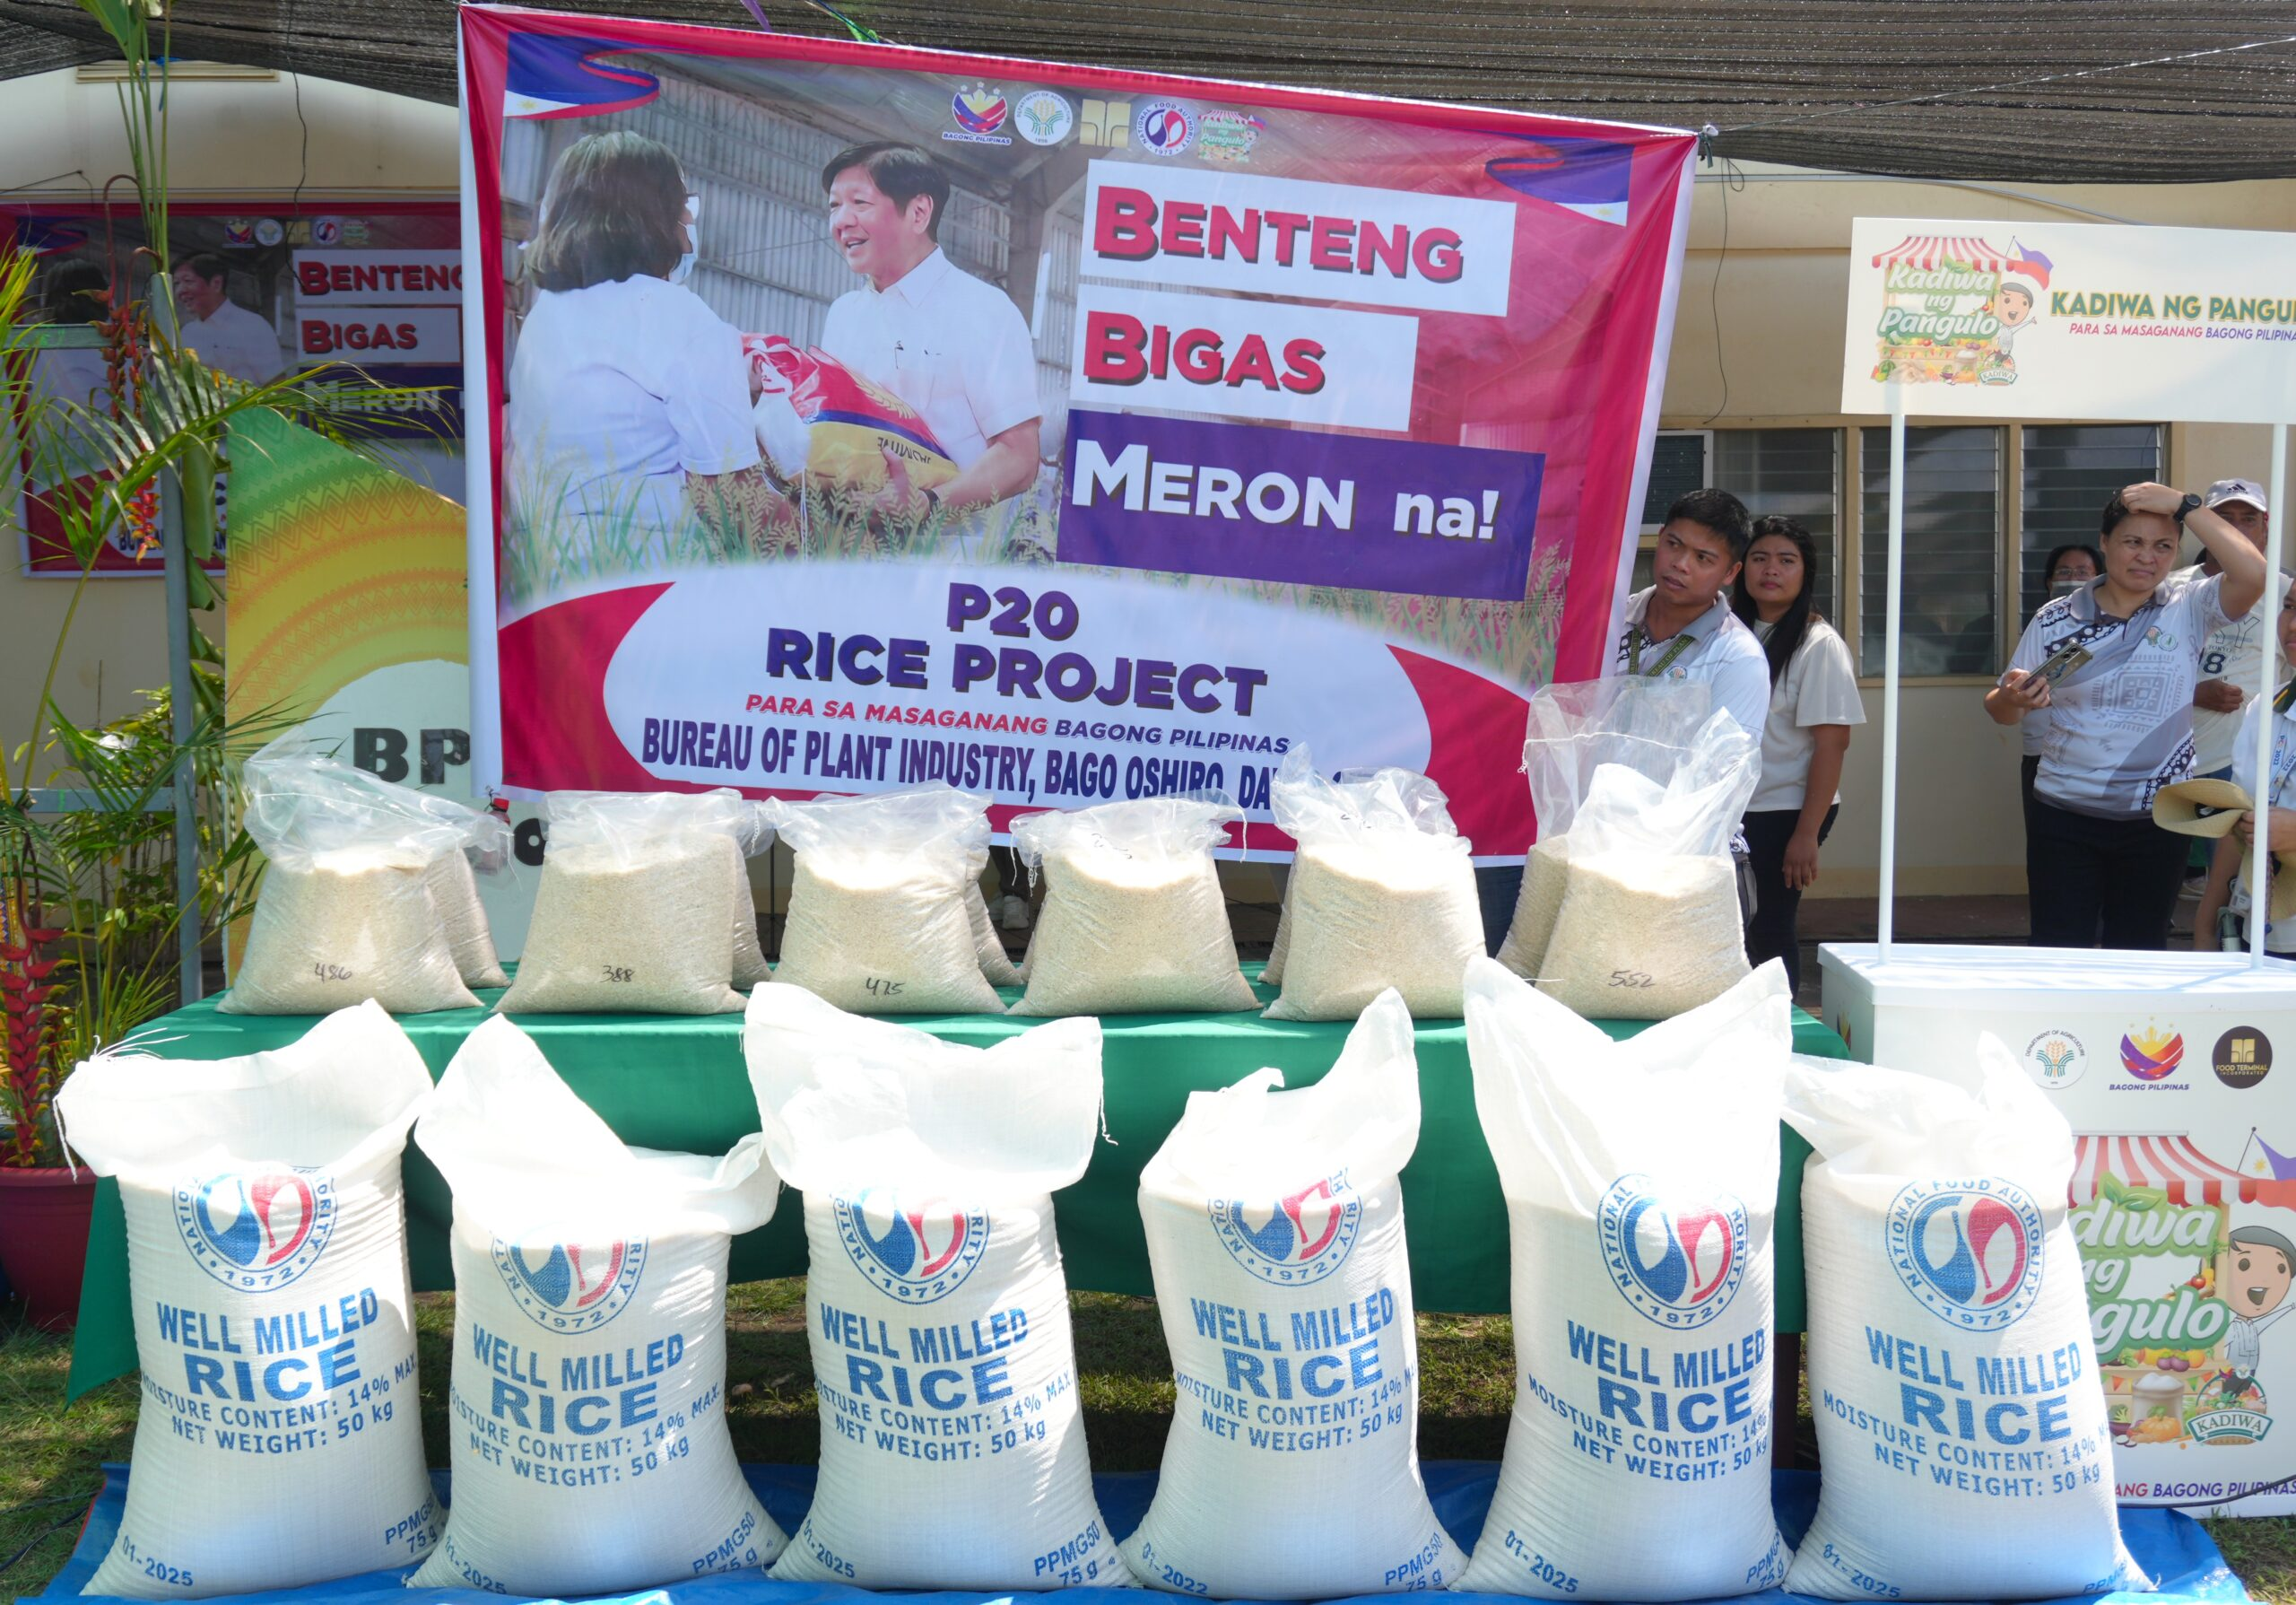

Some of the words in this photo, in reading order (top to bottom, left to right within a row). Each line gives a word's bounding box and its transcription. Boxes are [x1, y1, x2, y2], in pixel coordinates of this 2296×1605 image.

[1138, 109, 1151, 144] NATIONAL
[1154, 101, 1177, 109] FOOD
[1178, 108, 1194, 148] AUTHORITY
[1093, 185, 1464, 284] BENTENG
[1887, 264, 1996, 292] Kadiwa
[1926, 294, 1954, 312] ng
[1879, 308, 1999, 341] Pangulo
[2051, 292, 2155, 318] KADIWA
[2163, 294, 2202, 320] NG
[2069, 322, 2100, 336] PARA
[2103, 323, 2118, 336] SA
[2121, 324, 2204, 338] MASAGANANG
[2205, 327, 2253, 340] BAGONG
[301, 319, 419, 354] BIGAS
[1083, 310, 1326, 395] BIGAS
[1983, 371, 2014, 380] KADIWA
[1072, 439, 1355, 530] MERON
[1393, 490, 1500, 540] na!
[946, 581, 1080, 642] P20
[765, 627, 930, 690] RICE
[951, 642, 1268, 717] PROJECT
[745, 693, 814, 717] PARA
[822, 700, 857, 720] SA
[865, 704, 1048, 737] MASAGANANG
[1055, 720, 1162, 745] BAGONG
[1169, 728, 1290, 755] PILIPINAS
[641, 717, 753, 772] BUREAU
[761, 727, 798, 774] OF
[804, 730, 892, 781] PLANT
[898, 737, 1036, 804] INDUSTRY,
[1044, 749, 1118, 798] BAGO
[314, 963, 352, 983] 486
[599, 965, 635, 982] 388
[865, 977, 905, 996] 475
[1608, 970, 1655, 988] 552
[1603, 1184, 1633, 1288] NATIONAL
[1892, 1187, 1926, 1288] NATIONAL
[1997, 1186, 2040, 1297] AUTHORITY
[2068, 1198, 2216, 1248] diwa
[224, 1266, 294, 1287] 1972
[883, 1278, 947, 1299] 1972
[1263, 1261, 1328, 1281] 1972
[156, 1301, 241, 1354] WELL
[254, 1287, 378, 1355] MILLED
[538, 1309, 605, 1329] 1972
[821, 1302, 900, 1360] WELL
[909, 1307, 1029, 1364] MILLED
[1190, 1297, 1282, 1352] WELL
[1291, 1286, 1395, 1352] MILLED
[1649, 1304, 1714, 1324] 1972
[1942, 1306, 2012, 1325] 1972
[2092, 1289, 2223, 1355] gulo
[183, 1338, 361, 1403] RICE
[473, 1322, 547, 1390] WELL
[561, 1333, 684, 1391] MILLED
[1222, 1338, 1383, 1400] RICE
[1567, 1319, 1660, 1386] WELL
[1674, 1328, 1766, 1388] MILLED
[1865, 1325, 1964, 1391] WELL
[1976, 1341, 2082, 1396] MILLED
[221, 1399, 338, 1429] CONTENT:
[348, 1374, 390, 1409] 14%
[491, 1375, 659, 1435] RICE
[846, 1354, 1014, 1411] RICE
[1257, 1397, 1364, 1426] CONTENT:
[1371, 1375, 1402, 1409] 14%
[1597, 1376, 1752, 1435] RICE
[172, 1415, 206, 1444] NET
[214, 1427, 327, 1454] WEIGHT:
[337, 1411, 364, 1439] 50
[372, 1400, 393, 1424] kg
[518, 1435, 632, 1462] CONTENT:
[642, 1410, 685, 1448] 14%
[836, 1412, 866, 1444] NET
[874, 1428, 981, 1461] WEIGHT:
[991, 1428, 1017, 1454] 50
[1023, 1419, 1047, 1441] kg
[880, 1408, 992, 1436] CONTENT:
[1000, 1395, 1042, 1426] 14%
[1202, 1409, 1240, 1441] NET
[1248, 1425, 1352, 1452] WEIGHT:
[1360, 1413, 1382, 1439] 50
[1387, 1402, 1403, 1426] kg
[1528, 1373, 1623, 1446] MOISTURE
[1632, 1433, 1736, 1460] CONTENT:
[1823, 1389, 1927, 1456] MOISTURE
[1937, 1442, 2054, 1471] CONTENT:
[2061, 1438, 2096, 1466] 14%
[1900, 1382, 2073, 1446] RICE
[2196, 1414, 2263, 1435] KADIWA
[470, 1432, 502, 1466] NET
[511, 1454, 621, 1487] WEIGHT:
[631, 1451, 657, 1477] 50
[666, 1435, 690, 1458] kg
[1573, 1431, 1616, 1464] NET
[1625, 1454, 1727, 1482] WEIGHT:
[1733, 1446, 1752, 1471] 50
[1874, 1443, 1920, 1477] NET
[1930, 1463, 2044, 1497] WEIGHT:
[2053, 1470, 2076, 1494] 50
[2083, 1462, 2100, 1485] kg
[2153, 1482, 2223, 1497] BAGONG
[121, 1534, 195, 1587] 01-2025
[406, 1530, 426, 1554] 75
[692, 1511, 755, 1574] PPMG50
[1034, 1520, 1101, 1577] PPMG50
[1058, 1566, 1083, 1587] 75
